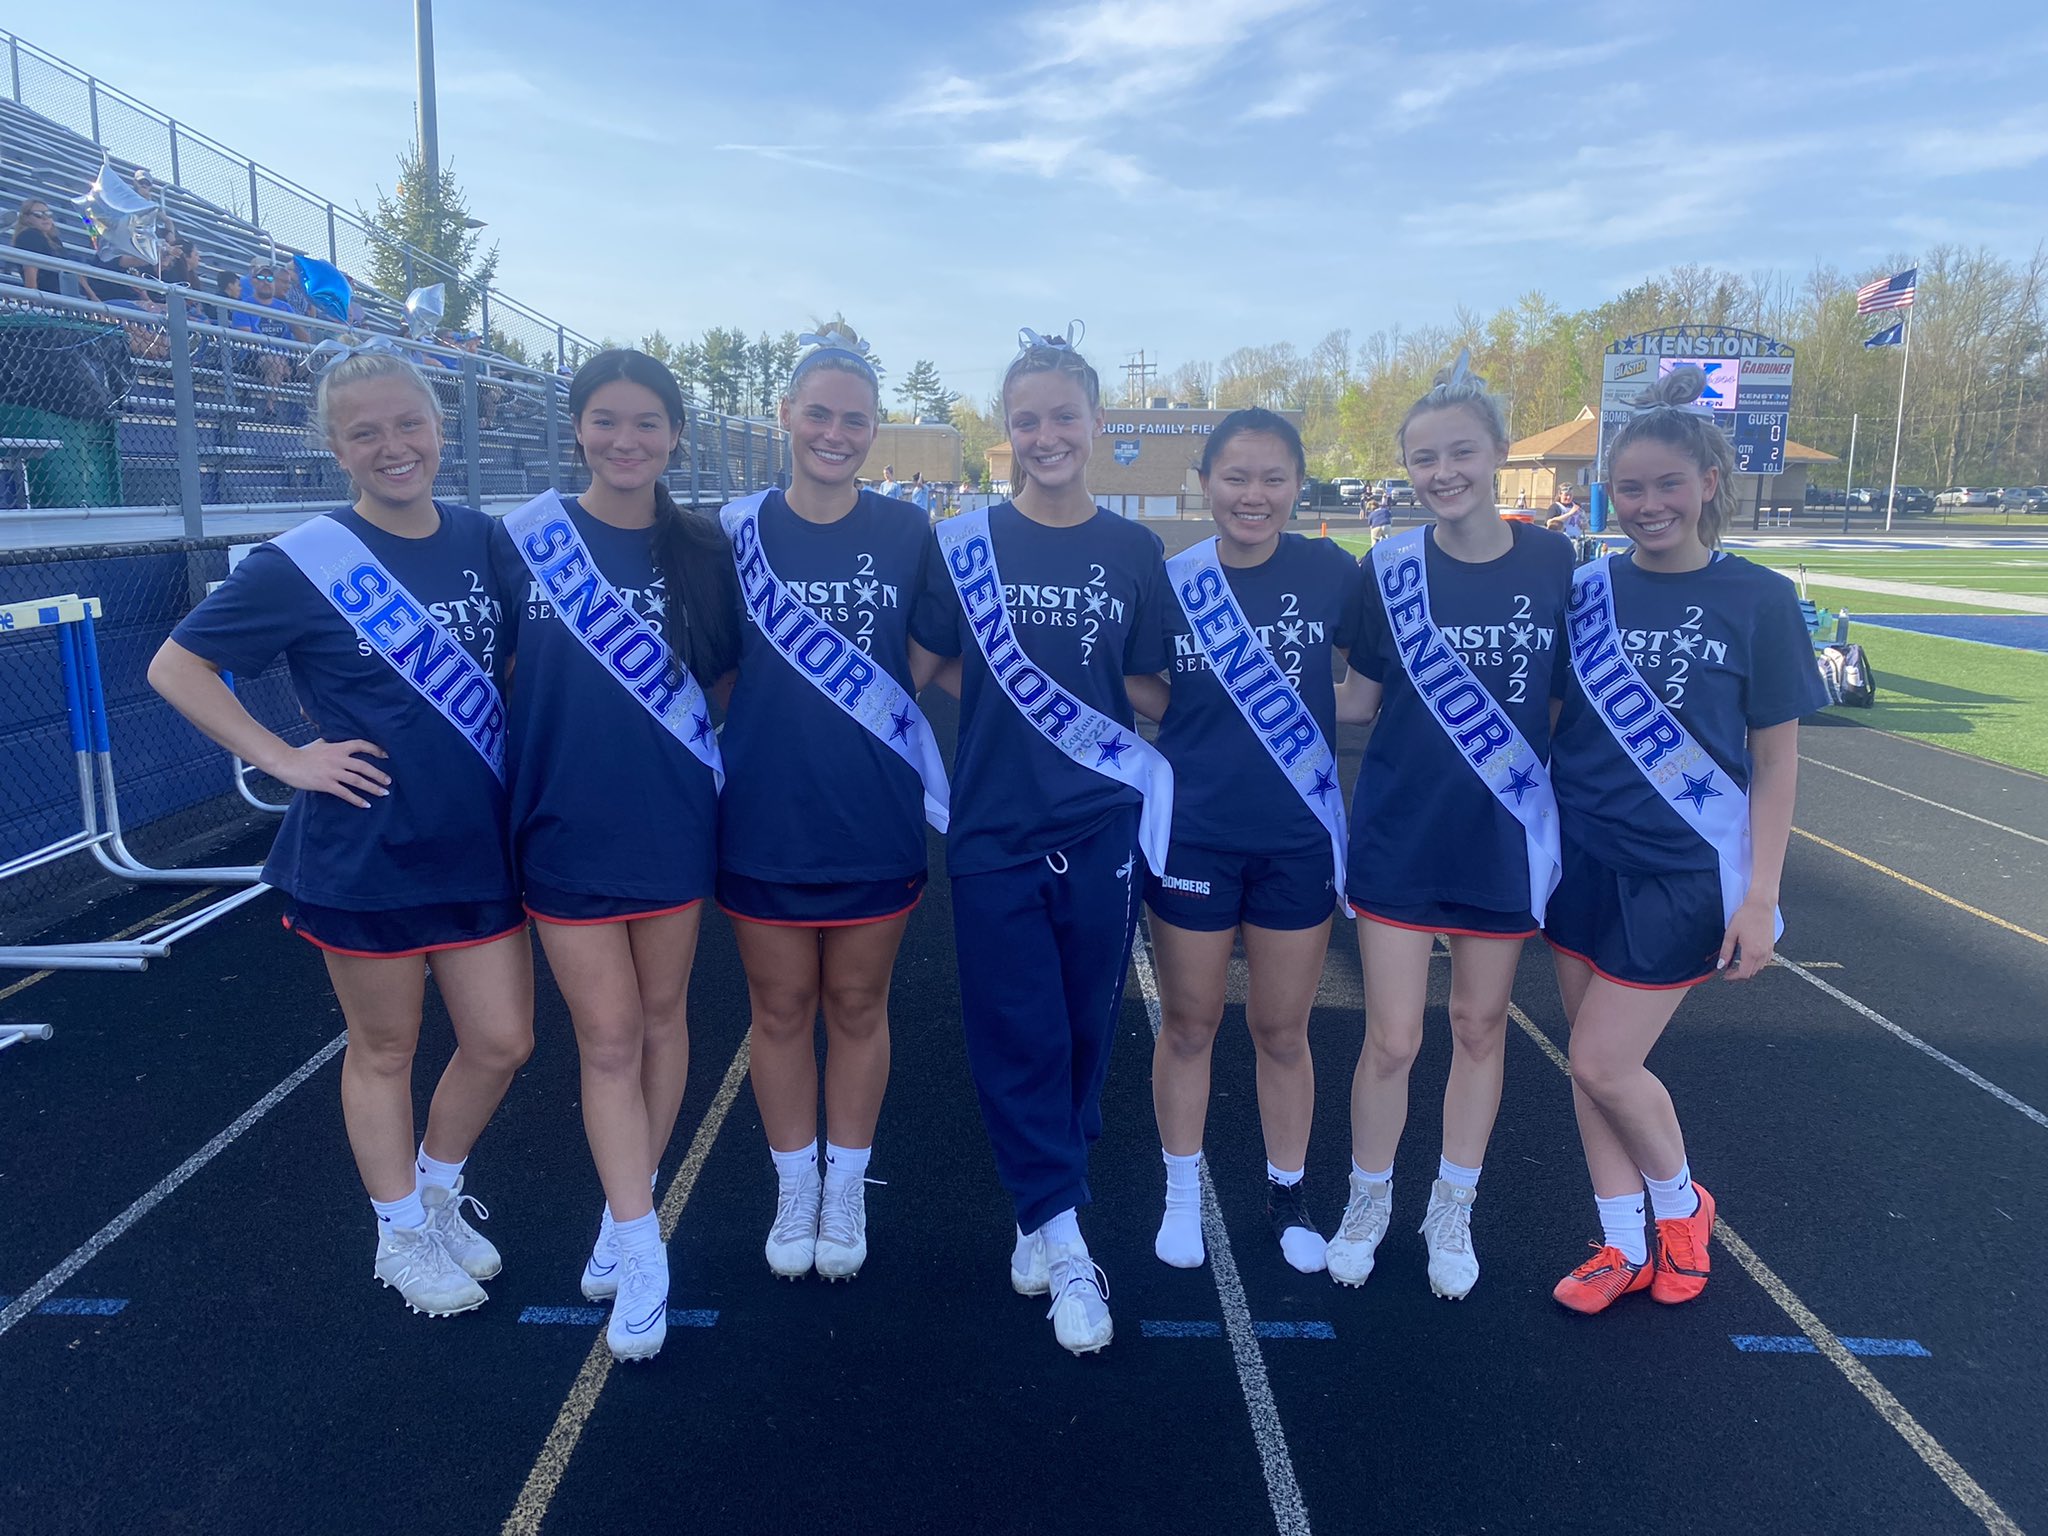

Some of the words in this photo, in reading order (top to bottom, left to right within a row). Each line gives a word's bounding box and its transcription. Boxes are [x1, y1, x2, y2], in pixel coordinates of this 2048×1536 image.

[1644, 336, 1758, 356] KENSTON
[1138, 423, 1185, 434] FAMILY
[1748, 413, 1783, 426] GUEST
[1770, 425, 1781, 441] 0
[1739, 454, 1750, 471] 2
[1770, 447, 1779, 460] 2
[522, 518, 690, 718] SENIOR
[732, 514, 877, 711] SENIOR
[1006, 610, 1077, 627] NIORS
[948, 534, 1082, 742] SENIOR
[330, 562, 505, 760] SENIOR
[1180, 566, 1319, 768] SENIOR
[1380, 555, 1514, 768] SENIOR
[1566, 570, 1685, 771] SENIOR
[1060, 713, 1098, 750] Captain
[1072, 718, 1112, 760] 2022
[1161, 874, 1211, 895] BOMBERS
